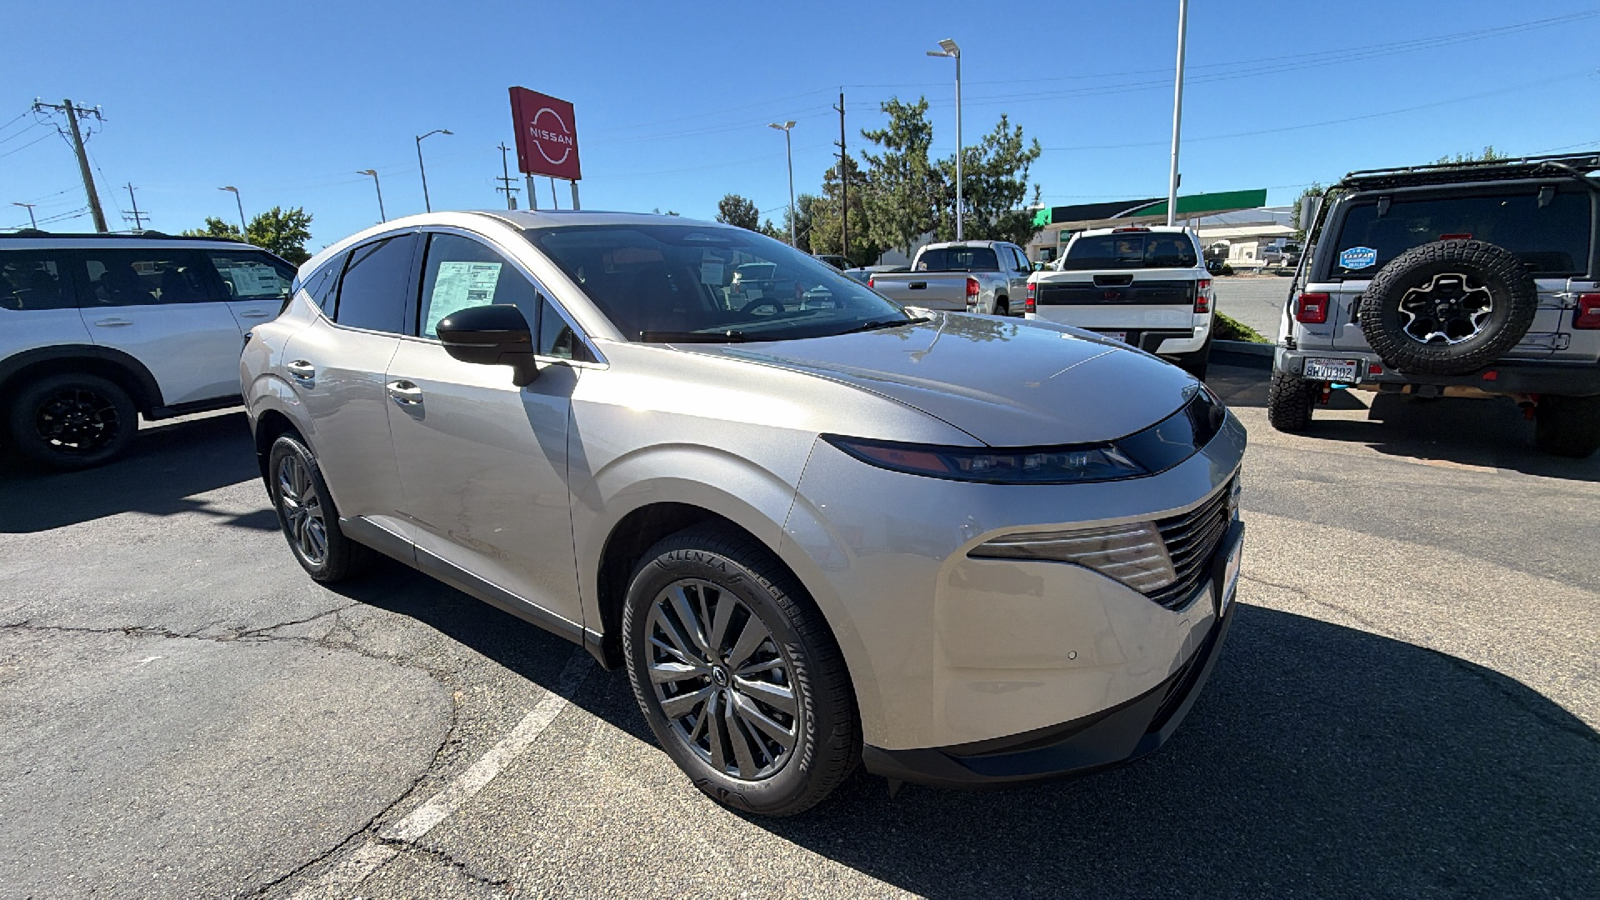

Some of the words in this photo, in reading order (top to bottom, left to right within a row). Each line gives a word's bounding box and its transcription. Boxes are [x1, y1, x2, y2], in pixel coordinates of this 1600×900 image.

[529, 126, 572, 146] NISSAN
[666, 550, 727, 573] ALENZA
[622, 598, 651, 715] BRIDGESTONE
[784, 642, 815, 773] BRIDGESTONE
